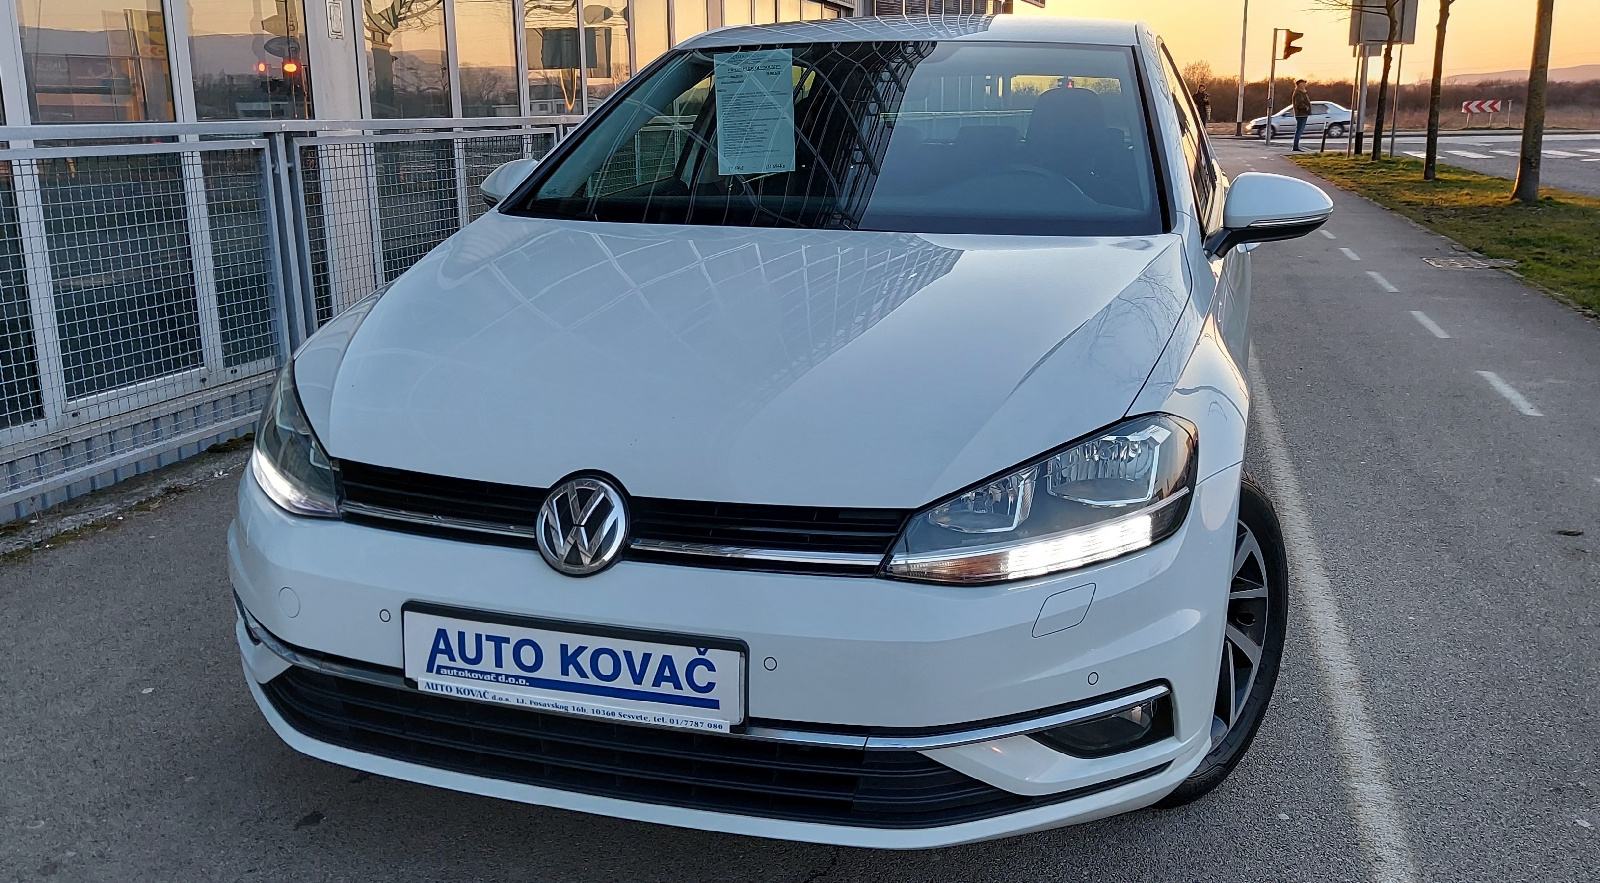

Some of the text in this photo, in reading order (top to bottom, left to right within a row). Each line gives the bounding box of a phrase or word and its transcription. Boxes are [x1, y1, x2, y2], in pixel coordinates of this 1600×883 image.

[425, 627, 717, 694] AUTO KOVAČ
[440, 667, 530, 686] autokovač d.o.o.
[424, 681, 453, 693] AUTO
[455, 685, 490, 700] KOVAČ
[591, 708, 616, 717] 10360
[669, 718, 704, 730] 01/7787
[707, 722, 723, 730] 080
